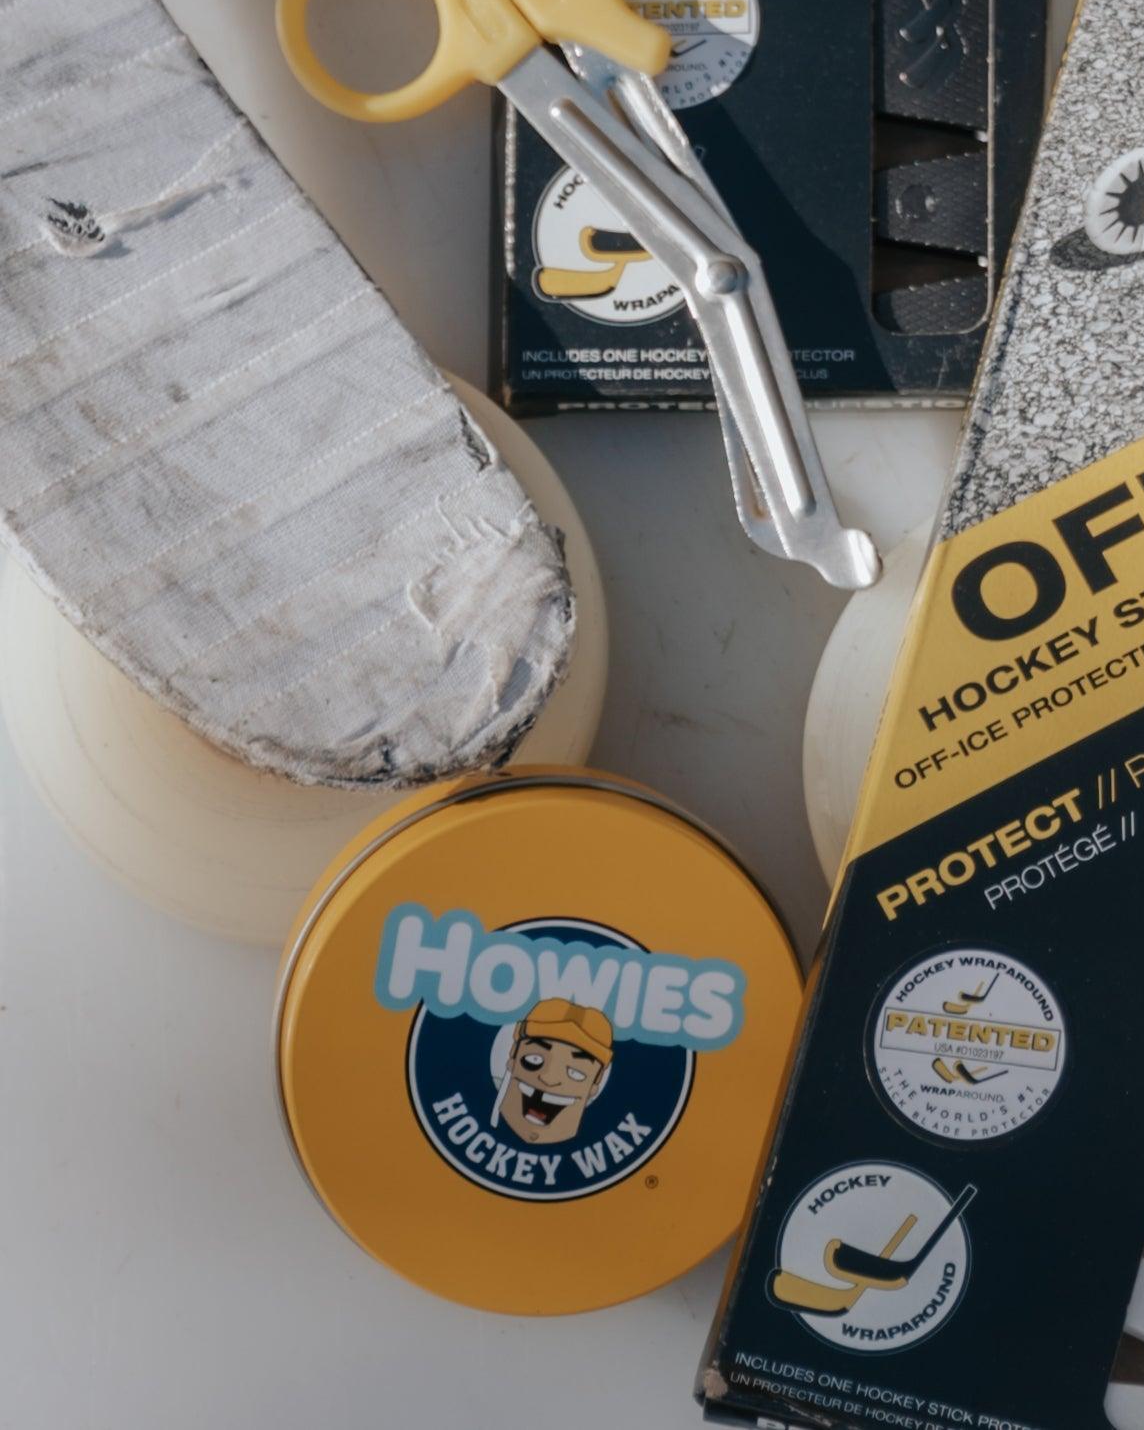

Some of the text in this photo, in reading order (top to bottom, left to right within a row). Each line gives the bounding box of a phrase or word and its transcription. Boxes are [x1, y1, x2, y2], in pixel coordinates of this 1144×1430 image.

[553, 174, 586, 210] HOC
[613, 284, 680, 312] WRAPA
[522, 348, 855, 363] INCLUDES ONE HOCKEY TECTOR
[522, 370, 541, 380] UN
[544, 369, 632, 381] PROTECTEUR
[633, 369, 651, 380] DE
[654, 369, 710, 381] HOCKEY
[918, 616, 1102, 732] HOCKEY
[894, 721, 1008, 790] OFF-ICE
[876, 790, 1089, 922] PROTECT
[983, 823, 1116, 911] PROTÉGÉ
[388, 914, 736, 1040] HOWIES
[896, 956, 1054, 1022] HOCKEY WRAPAROUND
[885, 1010, 1057, 1053] PATENTED
[933, 1041, 954, 1054] USA
[878, 1066, 1051, 1137] STICK BLADE PROTECTOR
[892, 1067, 1035, 1124] THE WORLD'S #1
[920, 1083, 1004, 1104] WRAPAROUND
[432, 1091, 652, 1186] HOCKEY WAX
[807, 1173, 893, 1215] HOCKEY
[839, 1261, 958, 1343] WRAPAROUND
[729, 1371, 751, 1388] UN
[752, 1377, 843, 1410] PROTECTEUR
[843, 1401, 864, 1416] DE
[865, 1406, 924, 1430] HOCKEY
[735, 1351, 815, 1384] INCLUDES
[817, 1373, 853, 1394] ONE
[855, 1383, 926, 1412] HOCKEY
[927, 1401, 974, 1425] STICK
